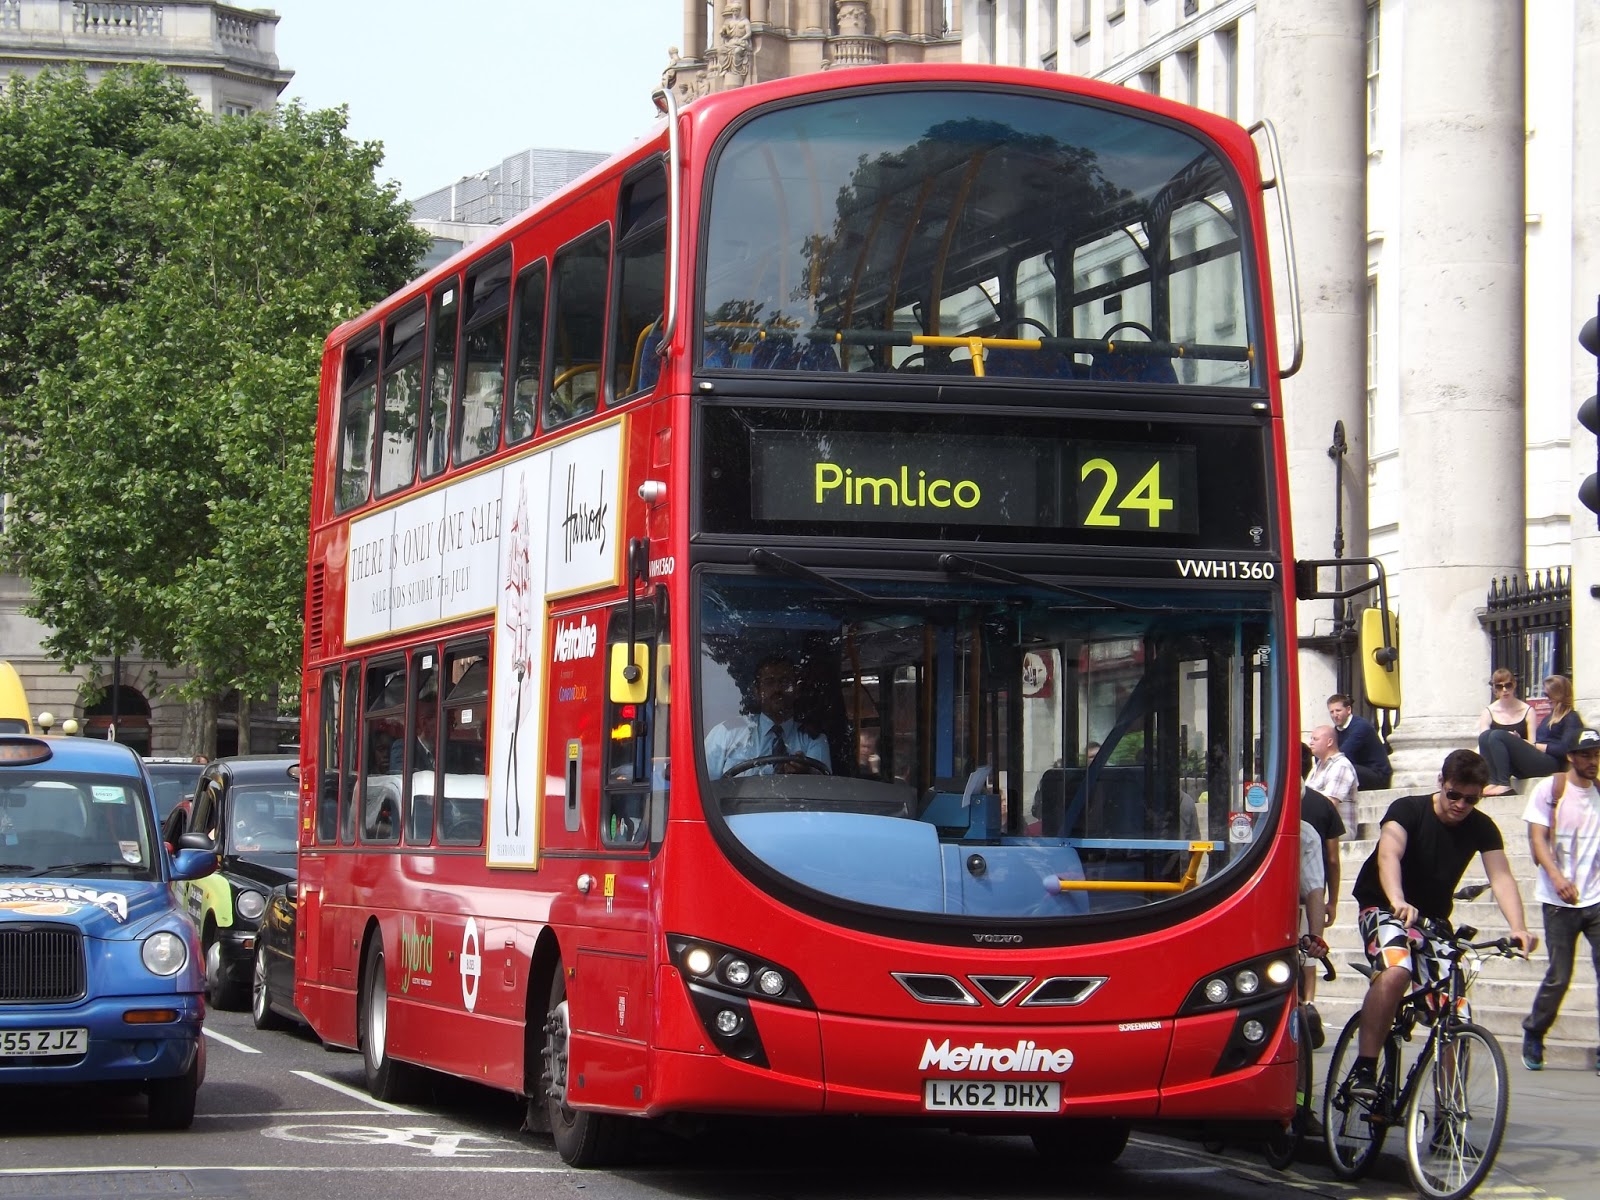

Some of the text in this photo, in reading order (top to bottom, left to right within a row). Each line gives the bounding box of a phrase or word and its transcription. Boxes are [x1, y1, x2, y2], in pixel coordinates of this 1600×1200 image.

[815, 462, 981, 509] Pimlico
[1081, 457, 1174, 529] 24
[562, 462, 607, 563] Harrods
[351, 498, 502, 582] THERE IS ONLY ONE SALE
[371, 589, 387, 614] SALE
[408, 577, 434, 606] SUNDAY
[450, 566, 471, 602] JULY
[1176, 559, 1275, 580] VWH1360
[553, 615, 597, 663] Metroline
[401, 915, 433, 994] hybrid
[972, 933, 1024, 943] VOLVO
[0, 1030, 78, 1051] 55 ZJZ
[1118, 1021, 1162, 1032] SCREENWASH
[918, 1038, 1074, 1073] Metroline
[932, 1083, 1049, 1107] LK62 DHX
